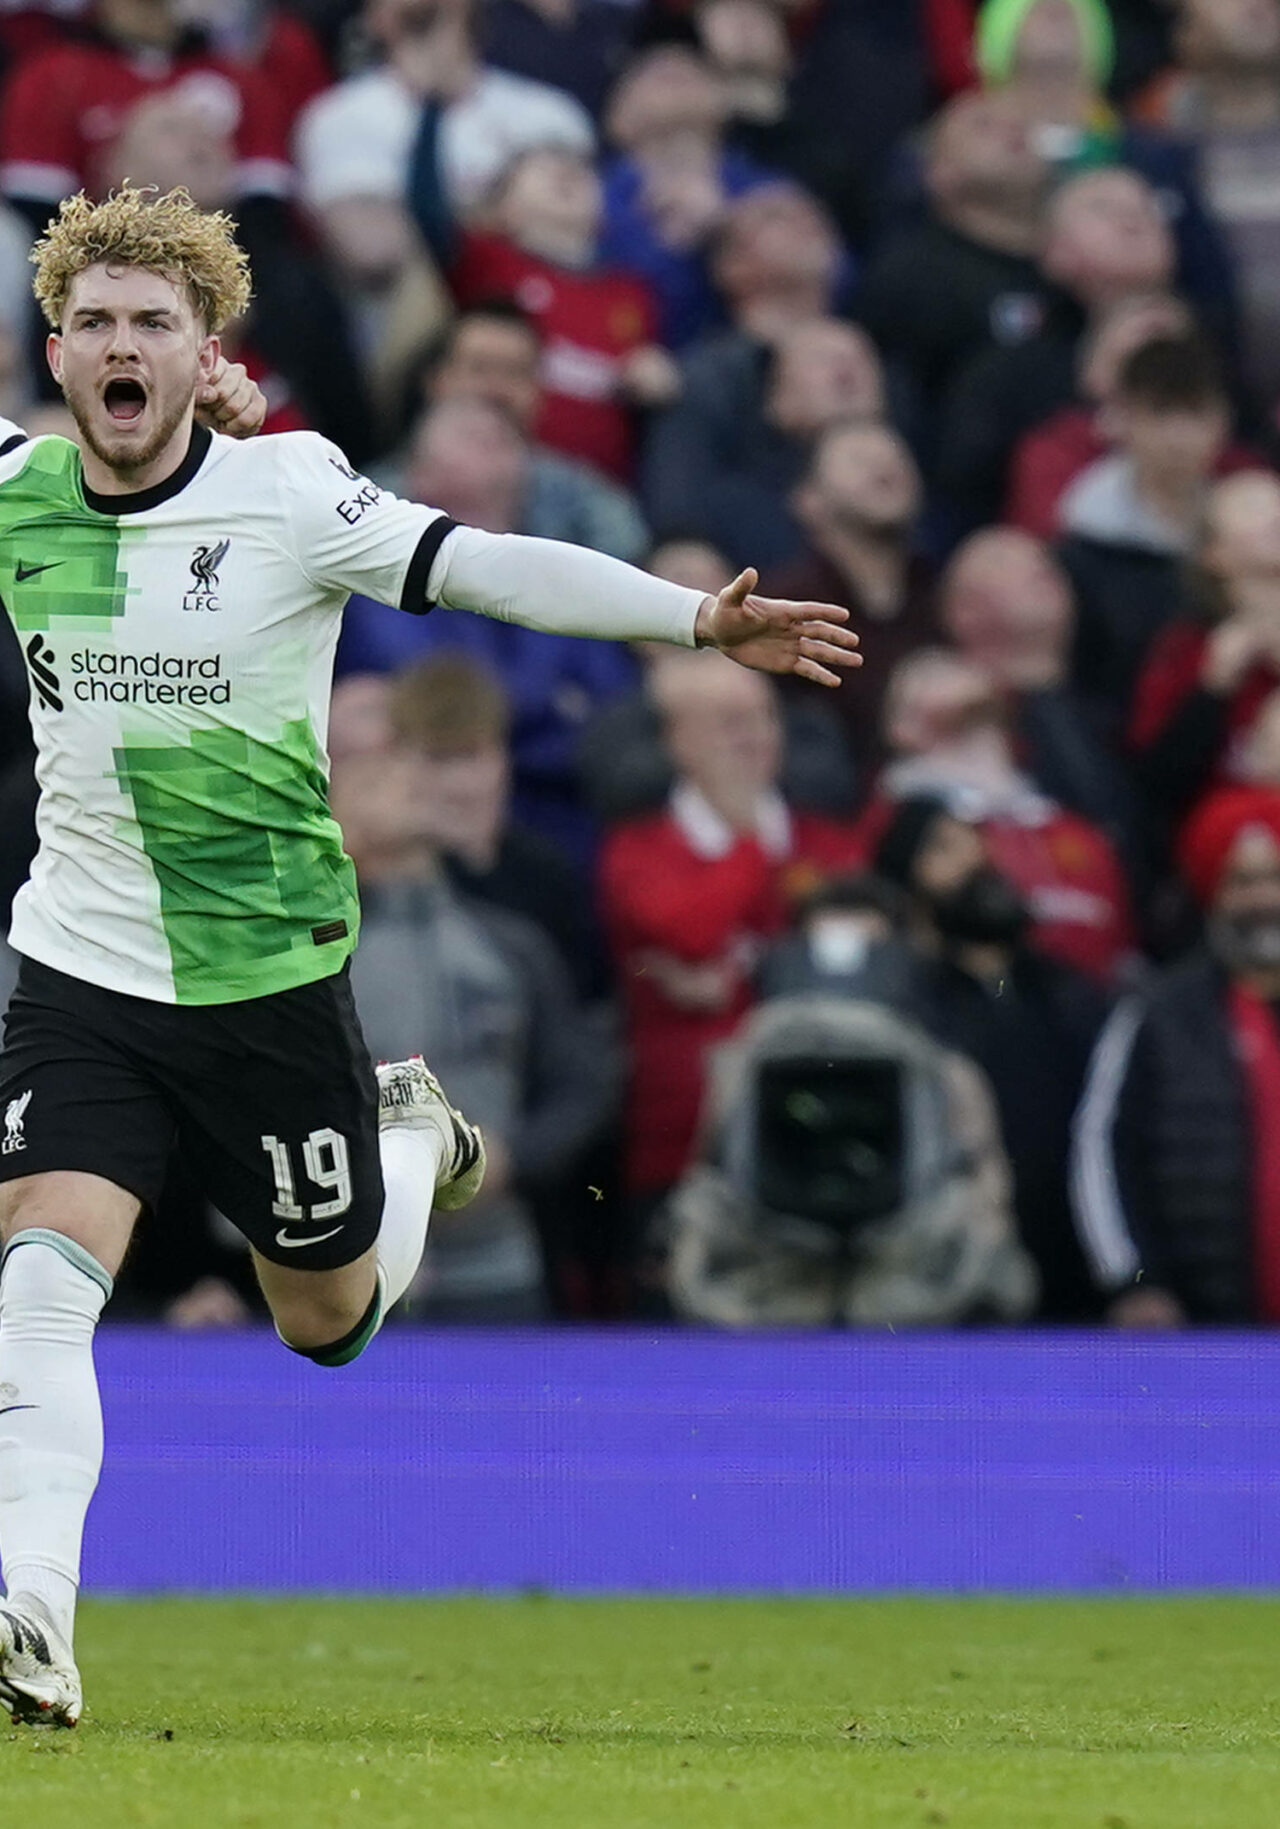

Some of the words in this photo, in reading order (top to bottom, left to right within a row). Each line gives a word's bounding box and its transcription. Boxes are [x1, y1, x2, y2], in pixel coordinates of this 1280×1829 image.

[71, 648, 220, 679] standard
[74, 676, 231, 705] chartered
[261, 1127, 352, 1220] 19
